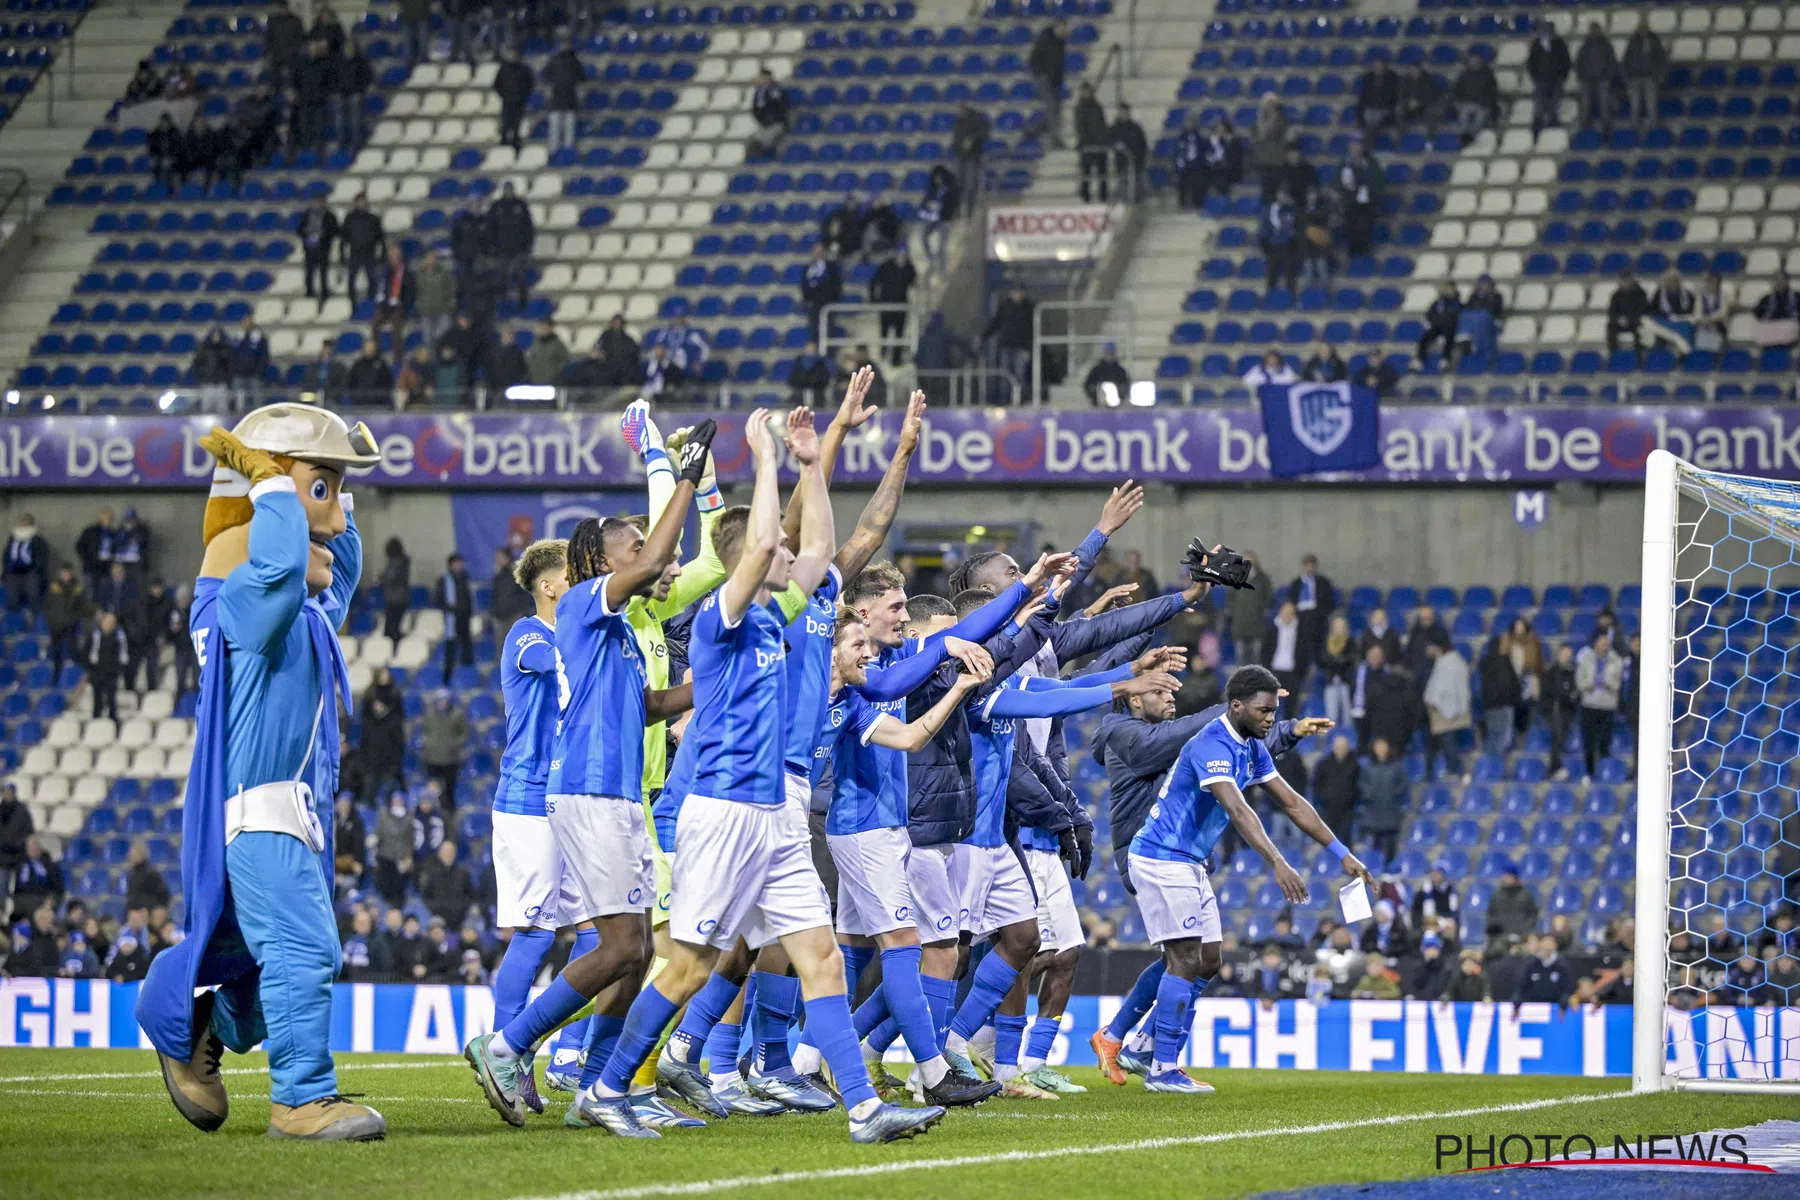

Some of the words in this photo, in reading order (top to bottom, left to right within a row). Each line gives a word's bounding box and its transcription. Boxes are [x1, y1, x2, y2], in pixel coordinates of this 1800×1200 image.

[362, 422, 603, 477] eobank
[920, 419, 1191, 473] beobank
[1515, 491, 1545, 522] M
[1350, 1000, 1551, 1075] FIVE
